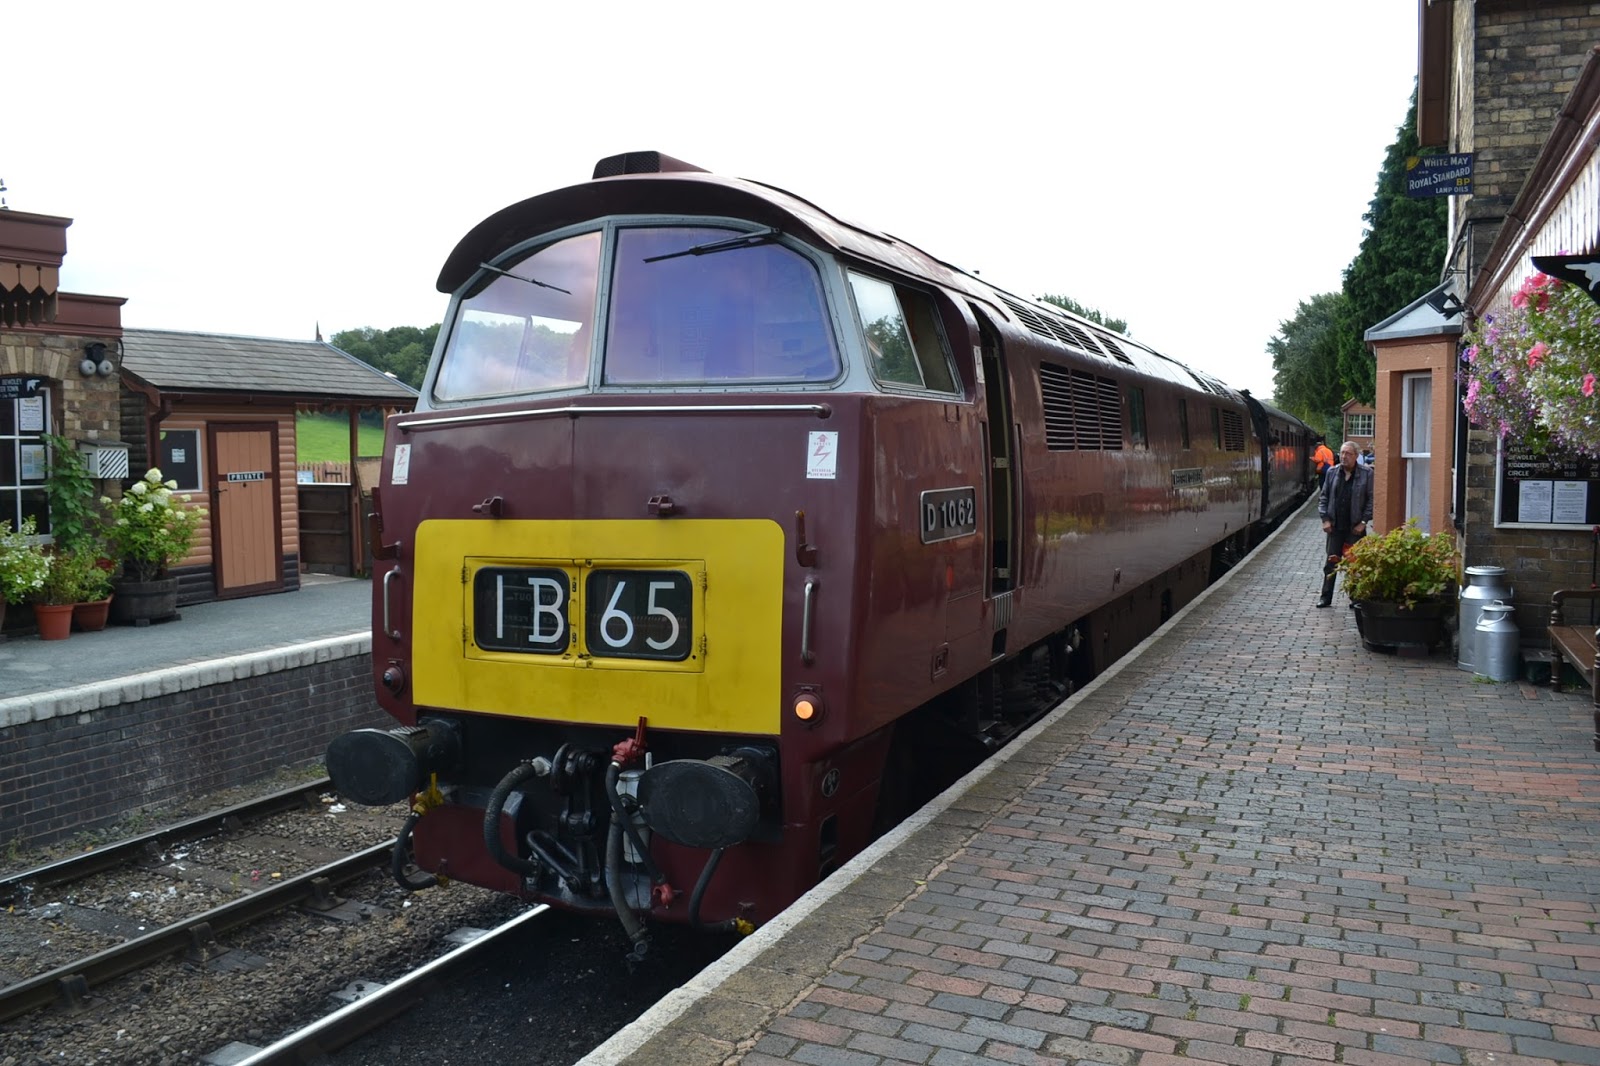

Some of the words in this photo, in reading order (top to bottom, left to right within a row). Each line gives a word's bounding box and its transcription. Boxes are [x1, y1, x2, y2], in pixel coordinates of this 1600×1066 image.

[1423, 158, 1448, 168] WHITE
[1450, 156, 1469, 166] MAY
[1409, 178, 1432, 191] ROYAL
[1432, 166, 1471, 184] STANDARD
[1456, 178, 1471, 186] BP
[231, 473, 262, 481] PRIVATE
